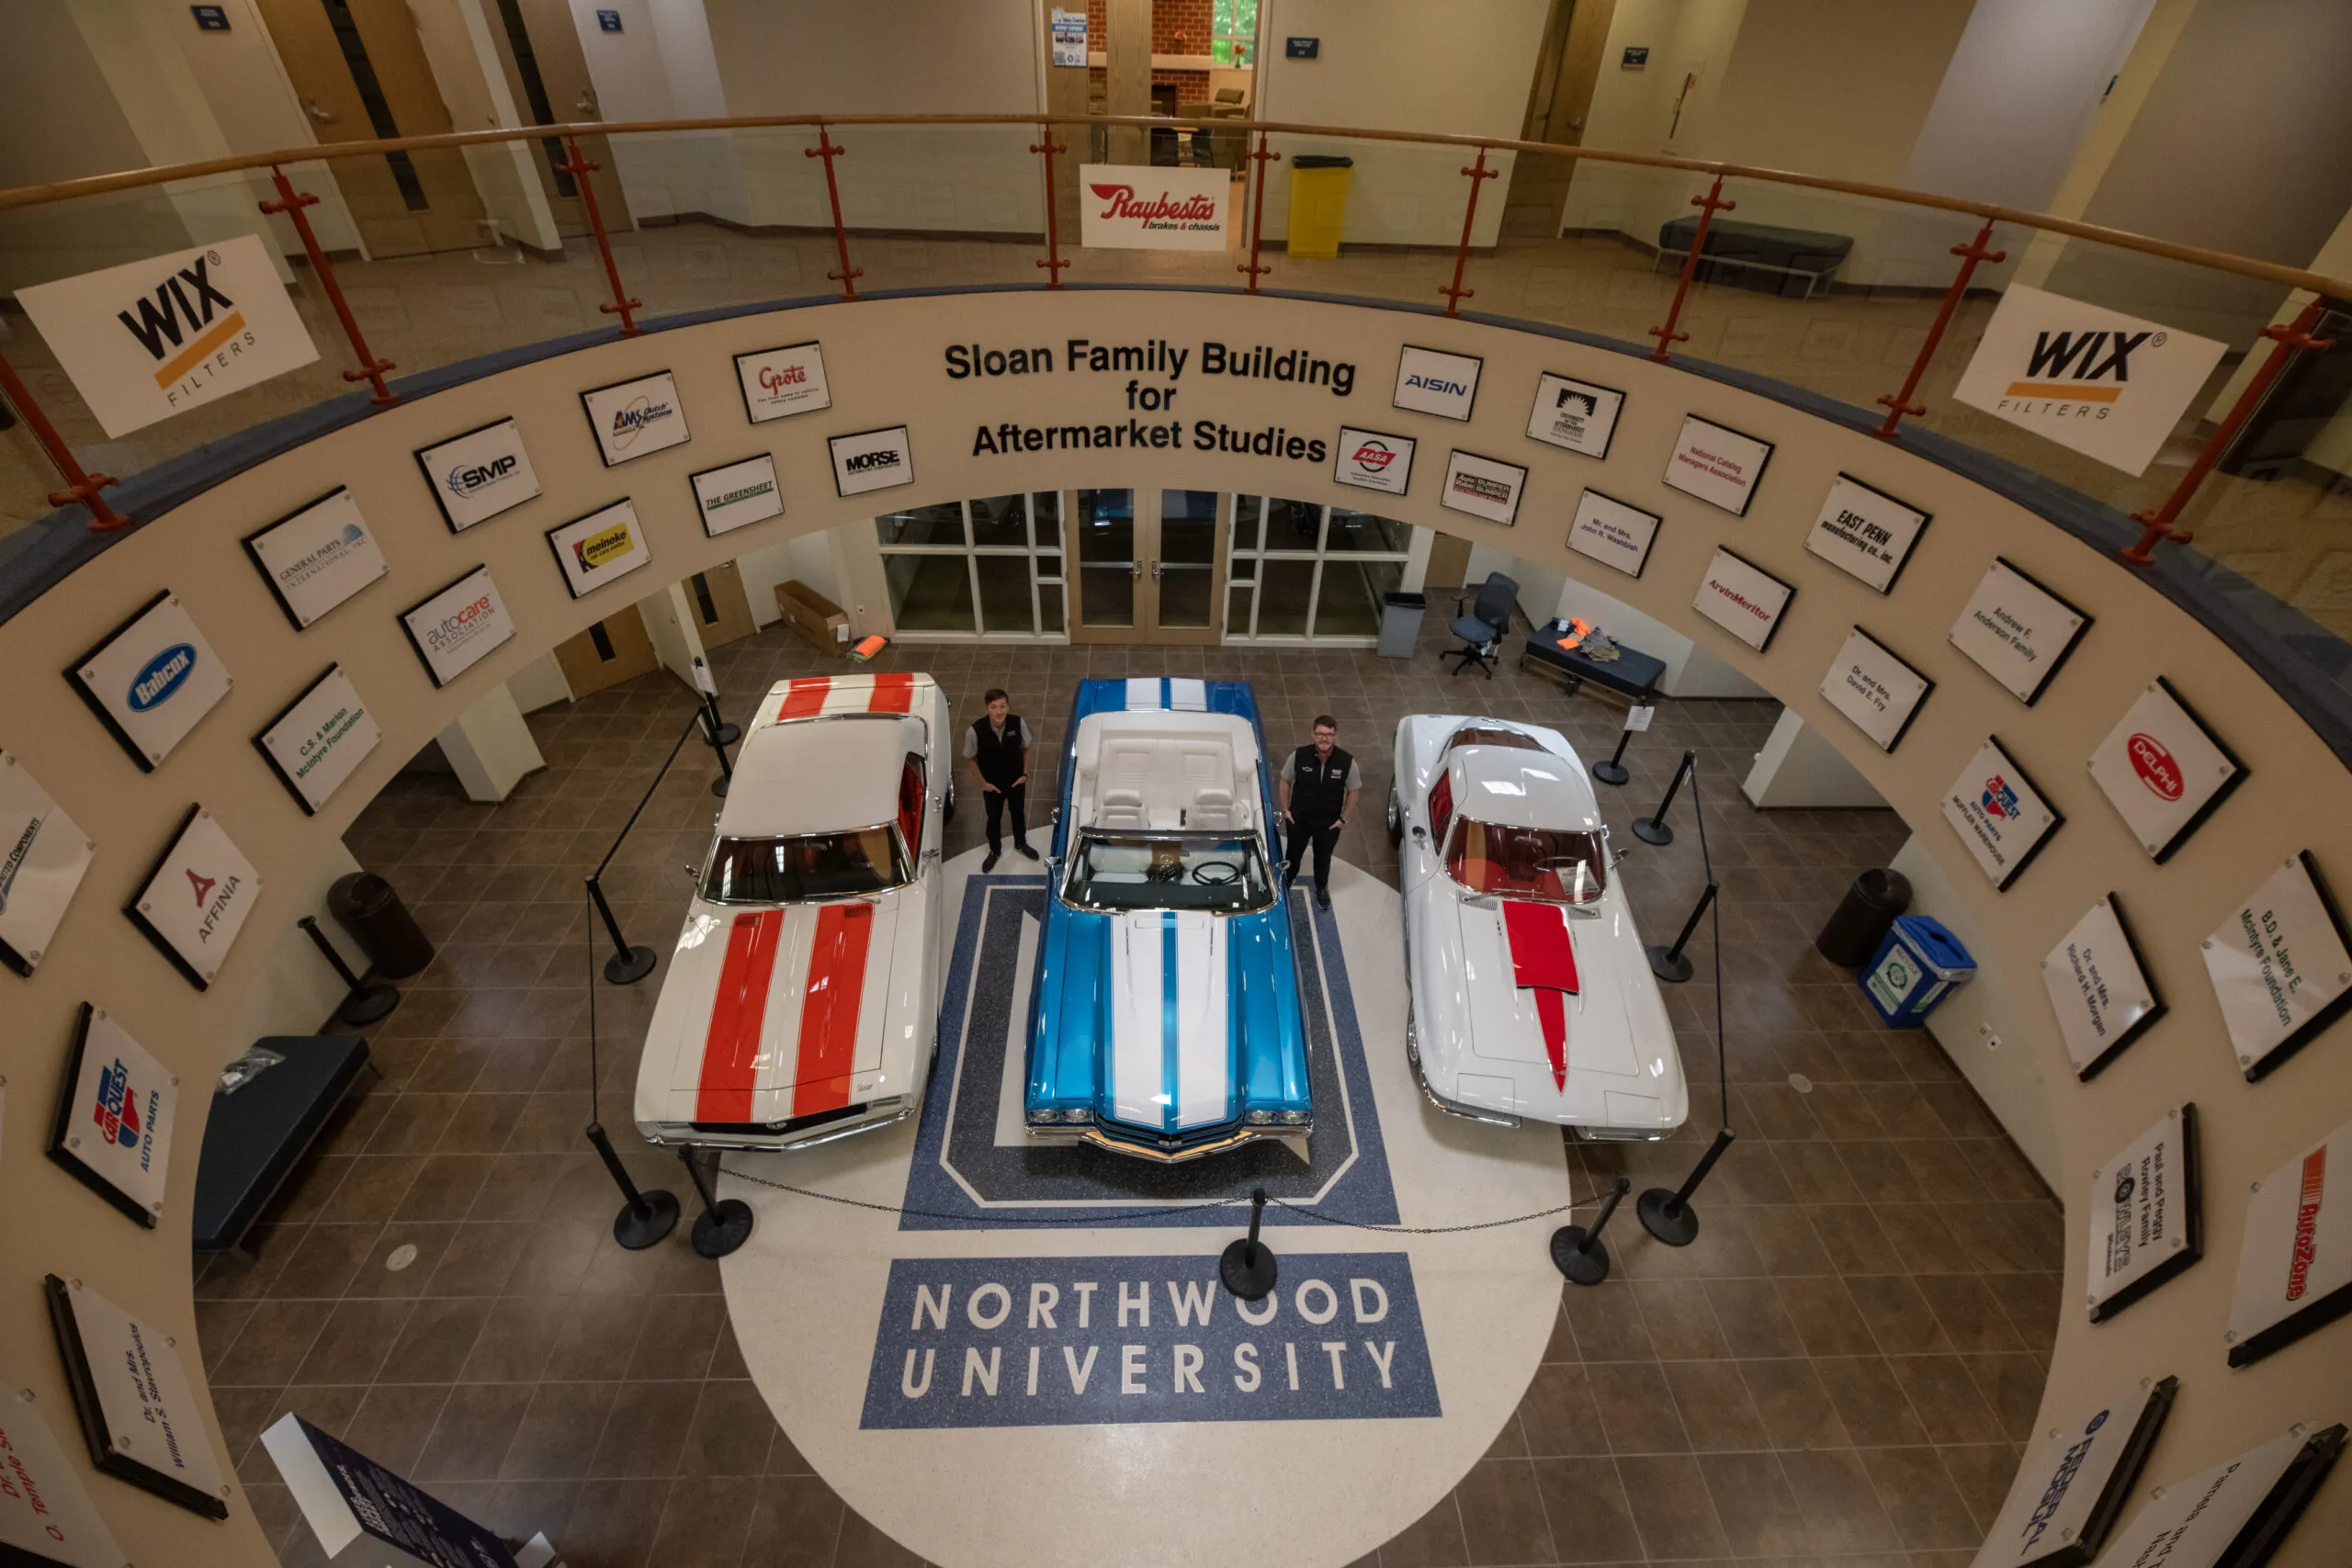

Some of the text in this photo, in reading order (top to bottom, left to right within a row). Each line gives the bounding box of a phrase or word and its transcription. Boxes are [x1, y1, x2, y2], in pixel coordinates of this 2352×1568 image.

[1090, 183, 1216, 229] Raybestos
[1148, 220, 1220, 231] brakes & chassis
[117, 255, 234, 361] WIX
[166, 332, 255, 407] FILTERS
[759, 366, 807, 395] Grote
[944, 339, 1357, 397] Sloan Family Building
[2026, 332, 2153, 381] WIX
[1125, 379, 1177, 412] for
[1405, 374, 1467, 397] AISIN
[1997, 400, 2111, 420] FILTERS
[845, 449, 900, 471] MORSE
[972, 419, 1328, 463] Aftermarket Studies
[1359, 451, 1388, 463] AASA
[1690, 446, 1743, 475] National Catalog
[462, 455, 516, 489] SMP
[706, 480, 773, 507] THE GREENSHEET
[1709, 465, 1747, 487] Association
[586, 530, 627, 556] meineke
[1580, 524, 1597, 535] John
[1592, 517, 1631, 540] Mr. and Mrs.
[1820, 520, 1869, 553] manufacturing
[1837, 509, 1893, 547] EAST PENN
[279, 538, 343, 581] GENERAL PARTS
[286, 548, 349, 591] INTERNATIONAL
[426, 595, 491, 645] autocare
[1709, 579, 1771, 622] ArvinMeritor
[1993, 606, 2025, 634] Andrew
[434, 607, 495, 652] ASSOCIATION
[1973, 610, 2038, 662] Anderson Family
[135, 650, 190, 705] Babcox
[1846, 674, 1867, 695] David
[1874, 697, 1887, 713] Fry
[1851, 665, 1862, 678] Dr.
[1862, 674, 1876, 688] and
[296, 707, 365, 780] McIntyre Foundation
[300, 707, 348, 757] C.S. & Marion
[2133, 740, 2177, 794] DELPHI
[9, 817, 40, 862] COMPONENTS
[1951, 795, 2006, 866] MUFFLER WAREHOUSE
[1970, 800, 2002, 841] AUTO PARTS
[198, 875, 242, 944] AFFINIA
[2240, 908, 2292, 1027] McIntyre Foundation
[2260, 909, 2303, 994] B.D. & Jane E.
[2066, 942, 2086, 984] Richard
[2086, 994, 2106, 1037] Morgan
[2082, 947, 2109, 1010] Dr. and Mrs.
[140, 1089, 160, 1173] AUTO PARTS
[2138, 1156, 2151, 1247] Rowley Family
[2152, 1142, 2165, 1241] Paul and Peggy
[2286, 1202, 2320, 1302] AutoZone
[910, 1277, 1390, 1330] NORTHWOOD
[126, 1349, 156, 1424] Dr. and Mrs.
[900, 1340, 1396, 1399] UNIVERSITY
[129, 1322, 185, 1469] William S. Stavropoulos
[8, 1455, 50, 1516] Temple
[2021, 1437, 2095, 1556] FEDERAL
[2022, 1443, 2081, 1538] MOGUL
[2157, 1461, 2242, 1558] Pamela and
